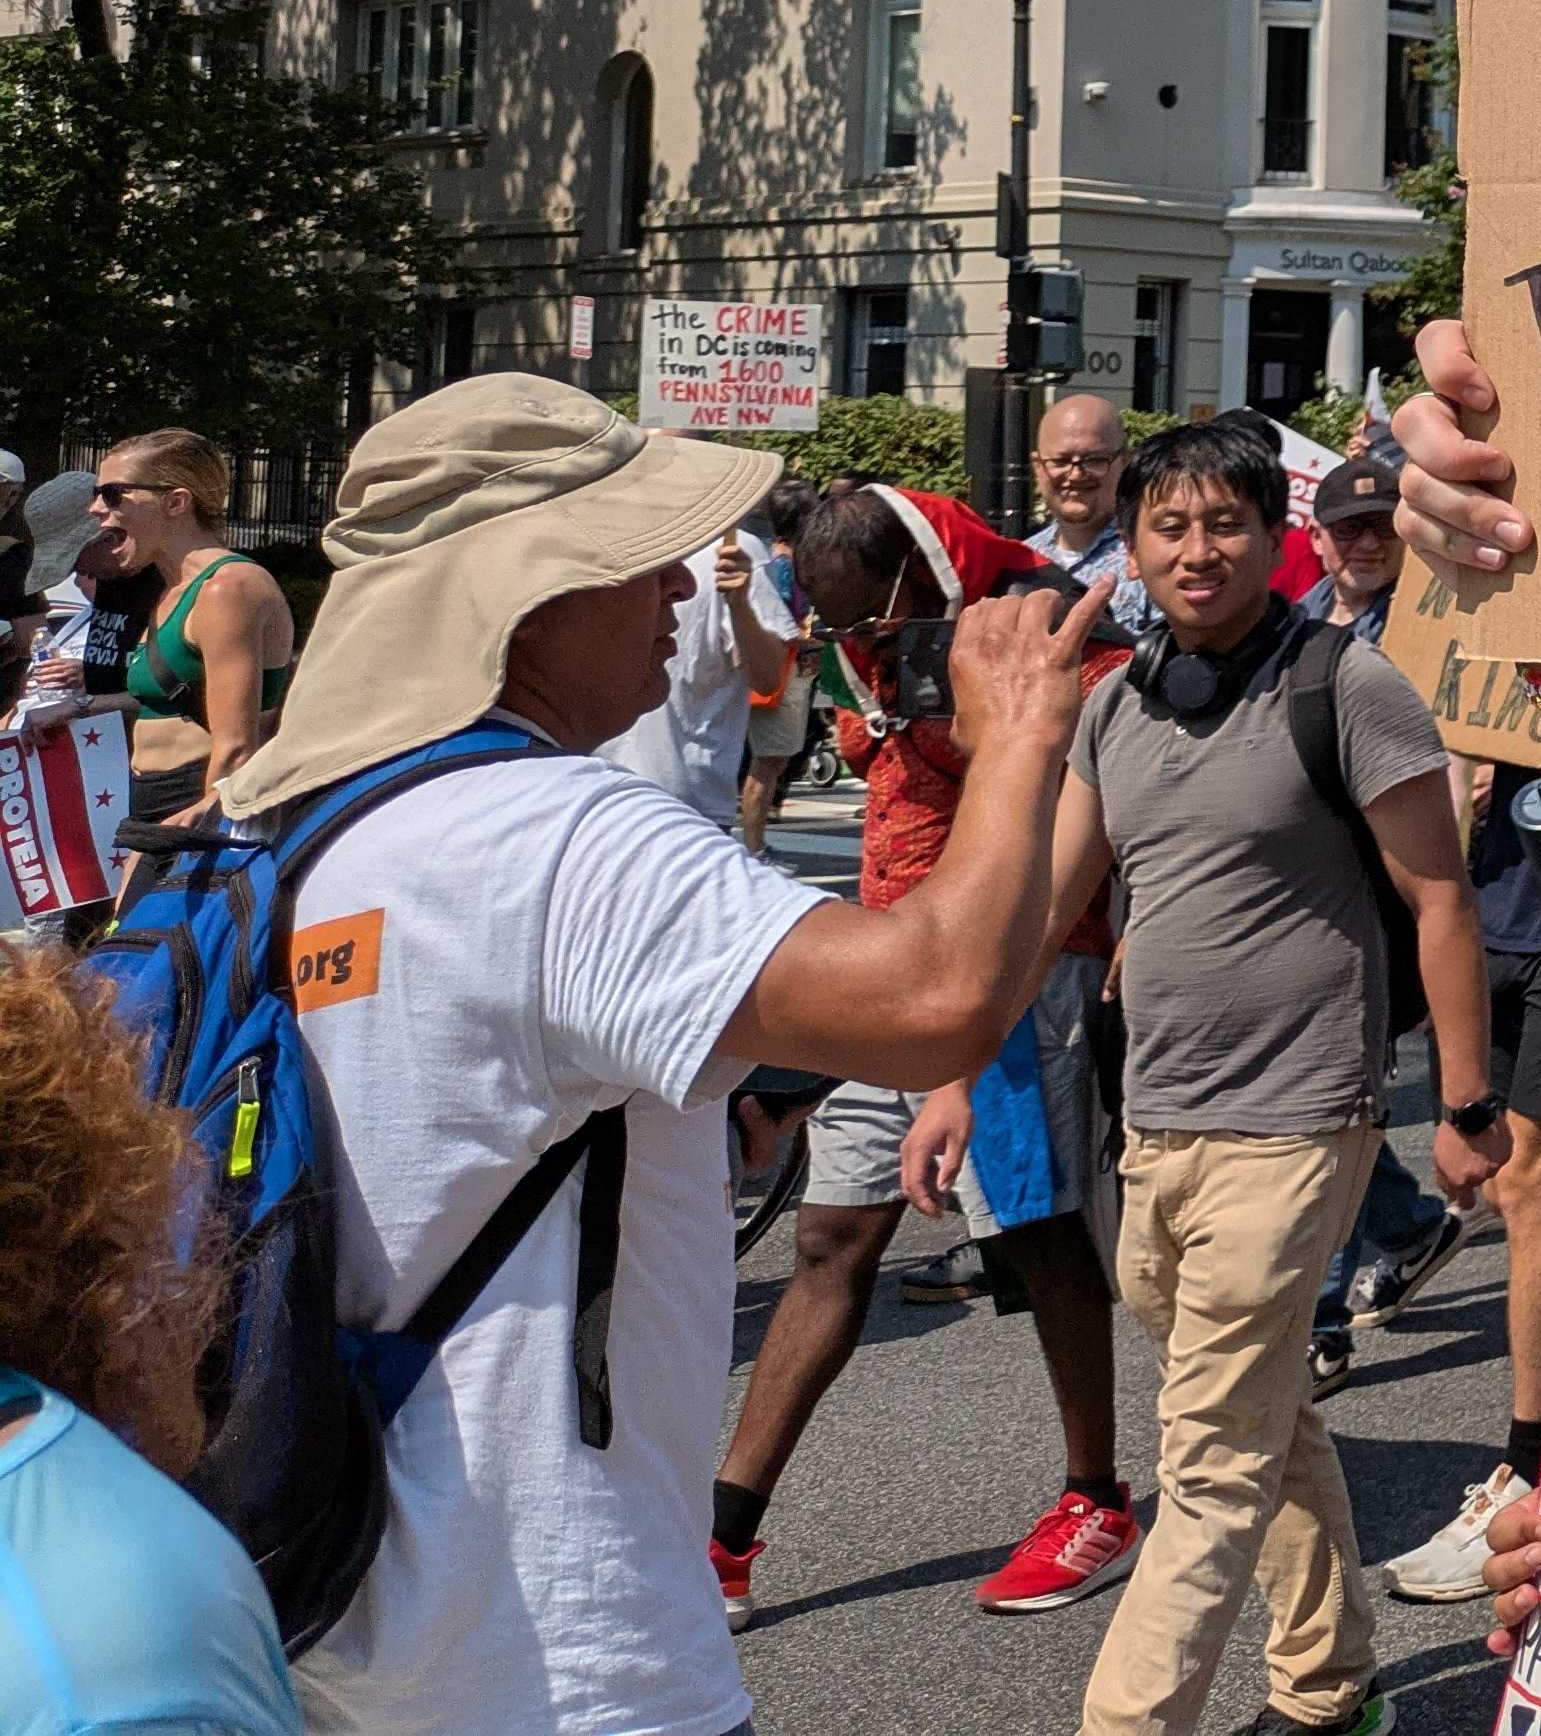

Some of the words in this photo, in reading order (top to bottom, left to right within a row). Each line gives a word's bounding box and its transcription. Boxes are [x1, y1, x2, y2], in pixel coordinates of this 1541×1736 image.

[1280, 249, 1342, 270] Sultan
[652, 304, 705, 329] the
[716, 305, 807, 336] CRIME
[659, 333, 682, 355] in
[697, 334, 727, 356] DC
[733, 336, 749, 356] is
[754, 340, 816, 373] coming
[658, 356, 706, 378] from
[719, 359, 783, 383] 1600
[659, 380, 814, 408] PENNSYLVANIA
[690, 406, 728, 425] AVE
[737, 407, 774, 425] NW
[0, 743, 50, 907] PROTEJA
